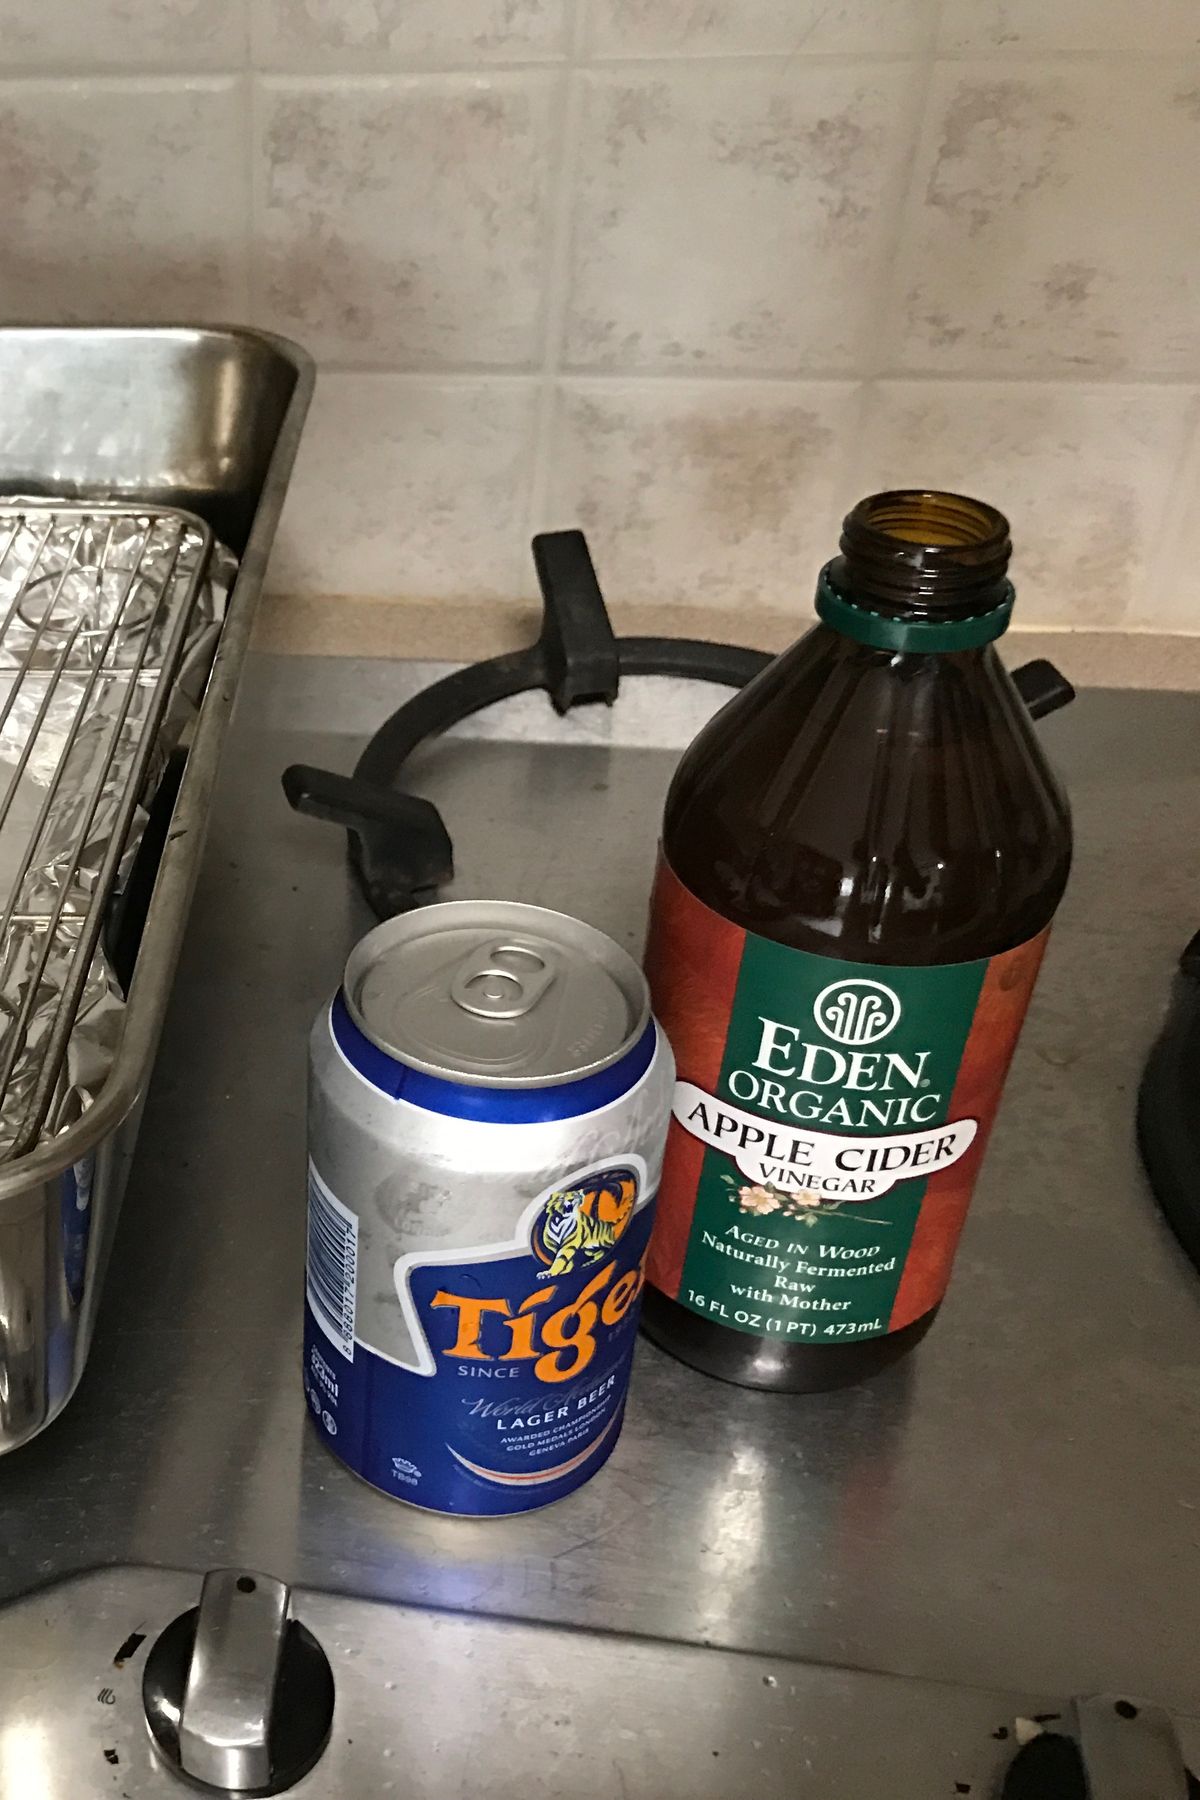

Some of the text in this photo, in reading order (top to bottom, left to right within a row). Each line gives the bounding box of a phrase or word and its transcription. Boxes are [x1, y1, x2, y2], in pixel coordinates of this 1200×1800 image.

[751, 1016, 932, 1092] EDEN
[728, 1069, 941, 1128] ORGANIC
[687, 1102, 956, 1173] APPLE CIDER
[758, 1162, 876, 1194] VINEGAR
[702, 1230, 897, 1278] Naturally Fermented
[730, 1282, 852, 1312] with Mother
[773, 1274, 817, 1293] Raw
[688, 1289, 706, 1307] 16
[709, 1301, 730, 1319] FL
[734, 1310, 762, 1328] OZ
[822, 1317, 883, 1336] 473mL
[456, 1364, 521, 1379] SINCE
[496, 1405, 569, 1431] LAGER
[576, 1374, 616, 1411] BEER
[500, 1429, 551, 1445] AWARDED
[506, 1441, 535, 1452] GOLD
[537, 1429, 573, 1447] MEDALS
[528, 1440, 566, 1457] GENEVA
